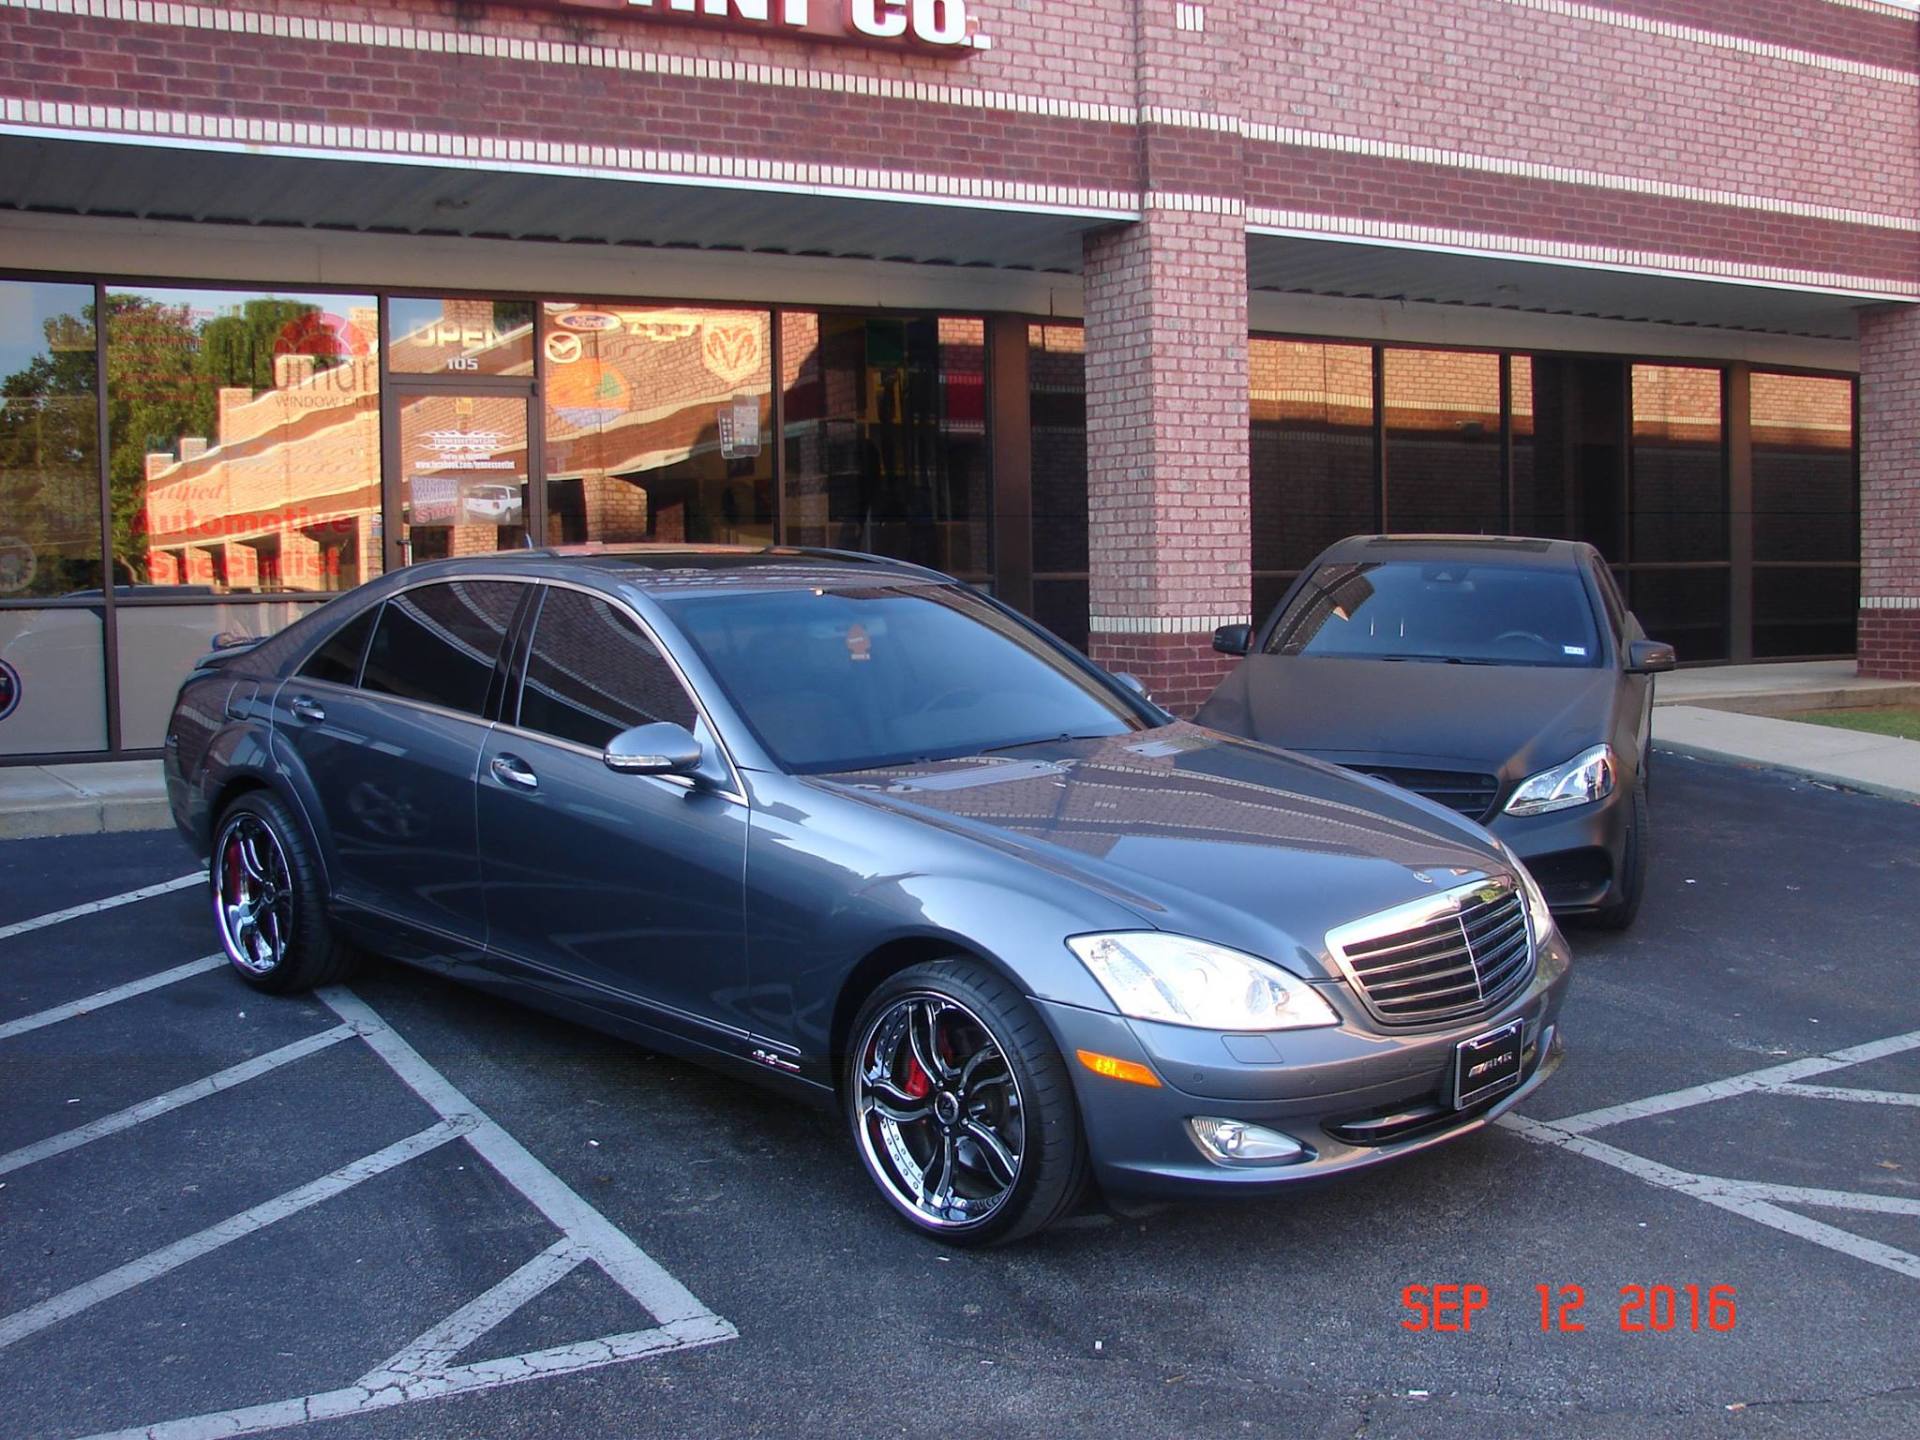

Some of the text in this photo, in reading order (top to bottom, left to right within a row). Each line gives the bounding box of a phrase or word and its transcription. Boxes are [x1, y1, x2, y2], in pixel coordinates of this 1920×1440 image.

[410, 319, 512, 349] OPEN
[447, 357, 479, 371] 105
[276, 396, 337, 408] WINDOW
[131, 507, 354, 536] Automotive
[145, 547, 341, 582] Specialist
